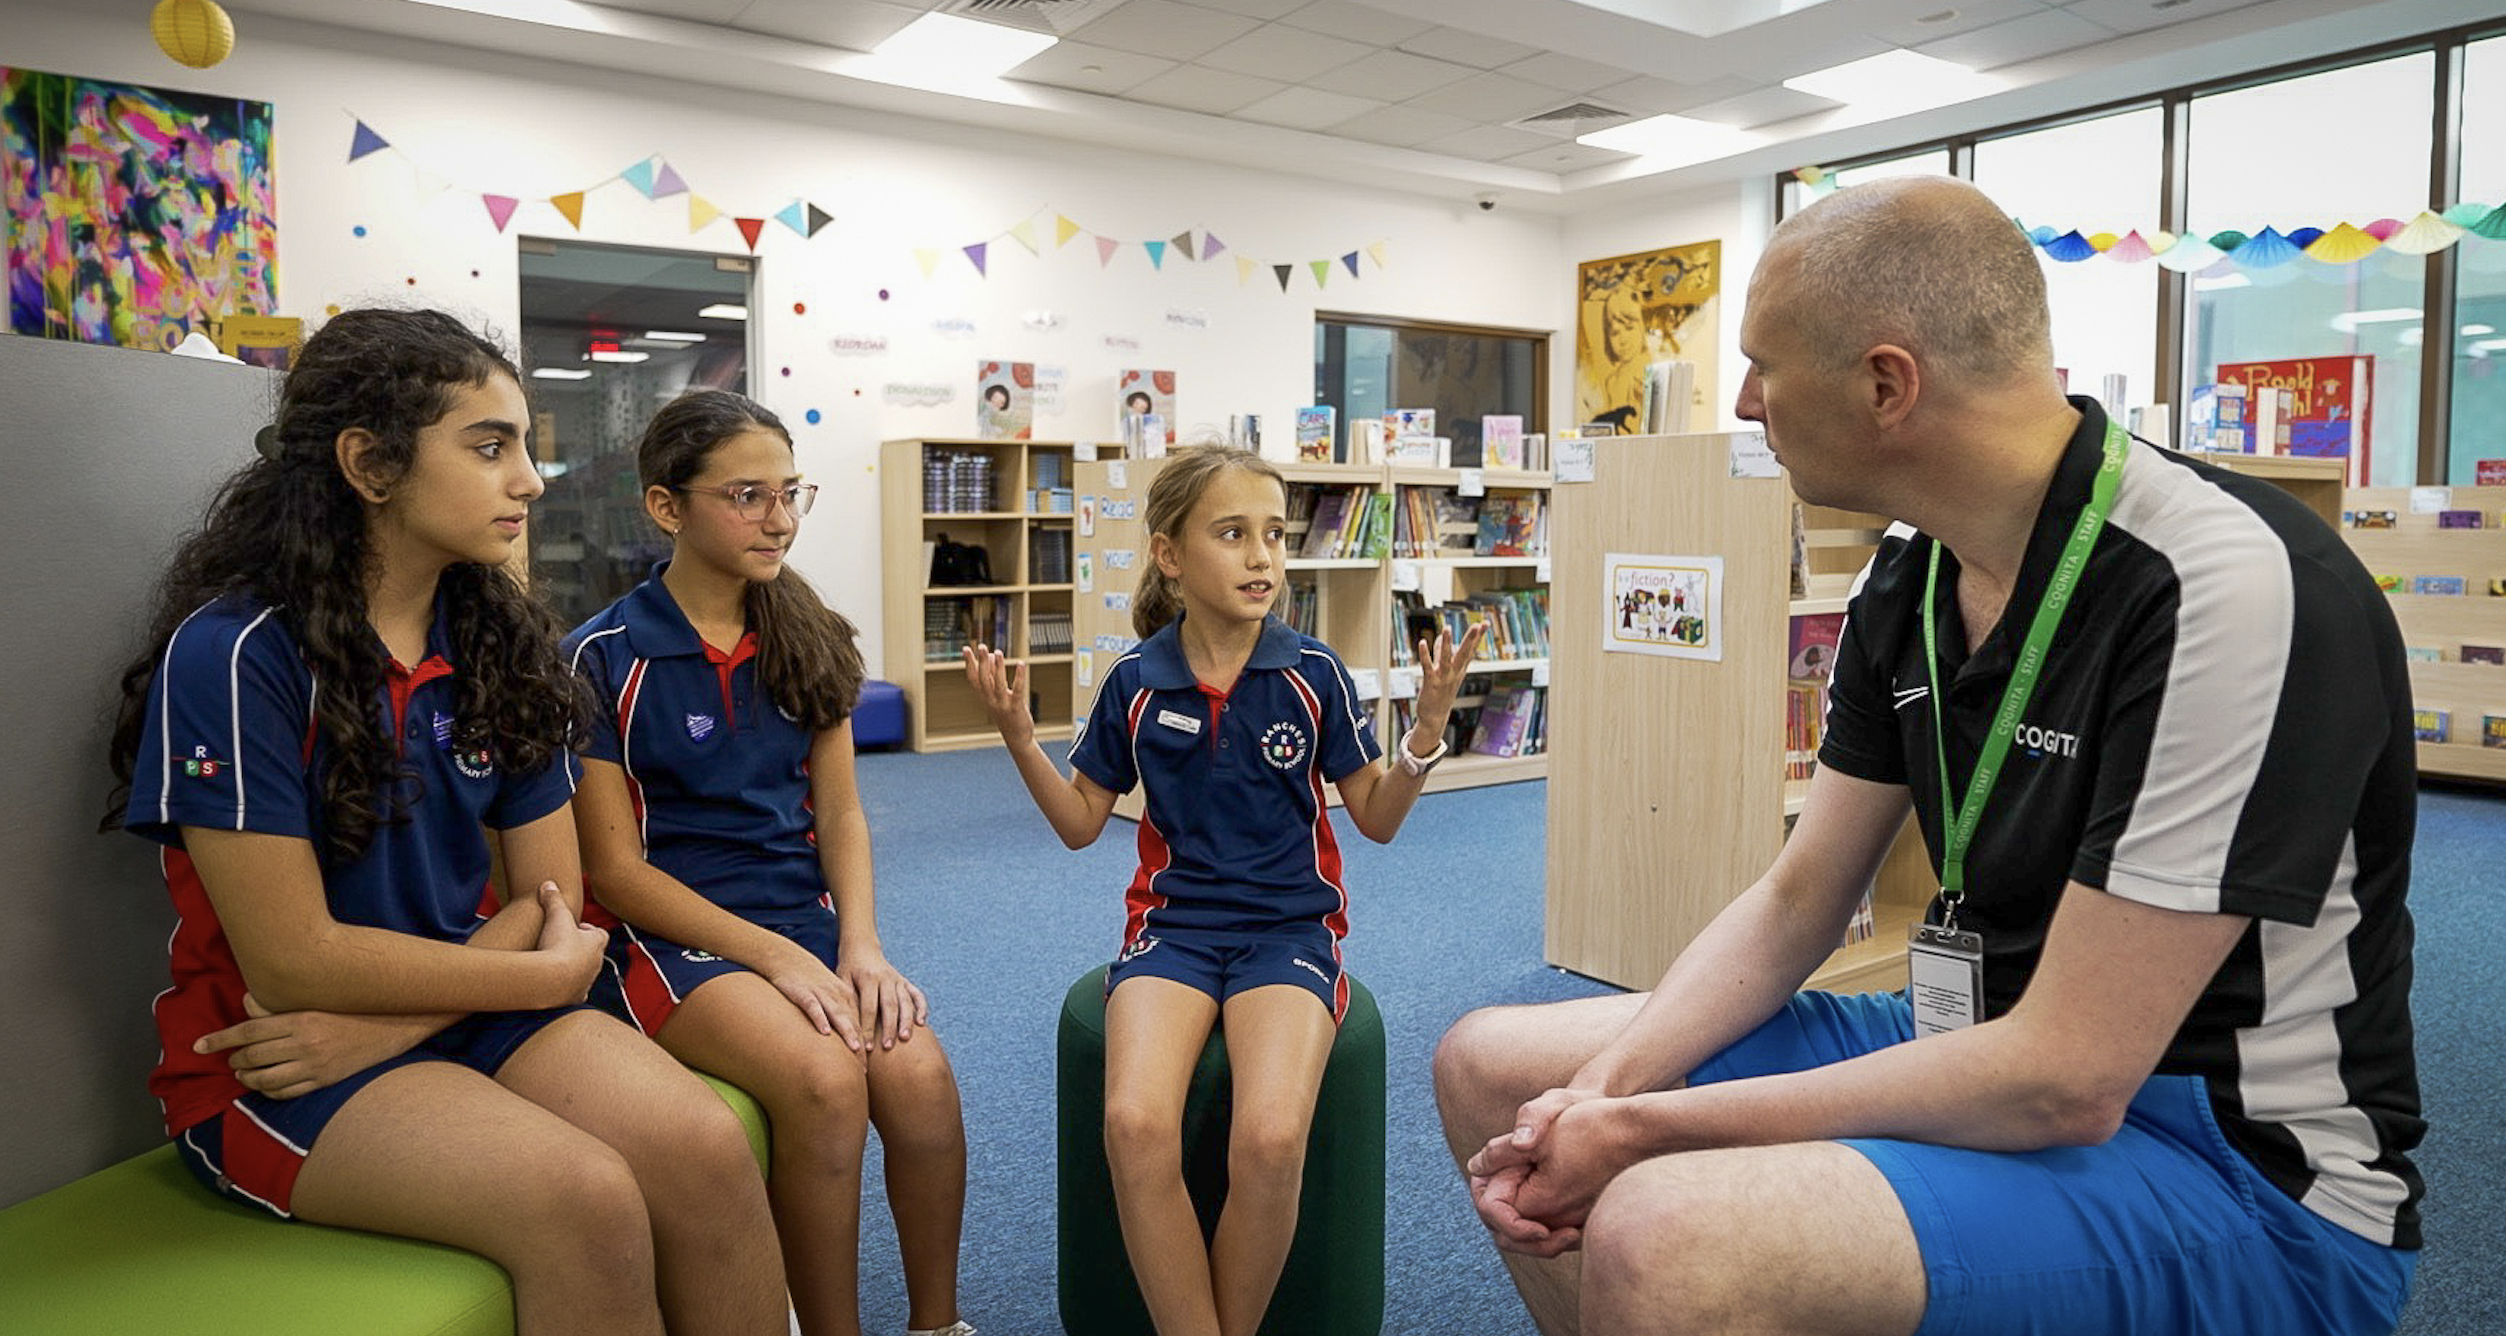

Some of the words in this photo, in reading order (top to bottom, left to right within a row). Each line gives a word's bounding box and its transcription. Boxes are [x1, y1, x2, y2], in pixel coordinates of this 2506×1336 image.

[128, 277, 257, 317] LOVE
[2242, 362, 2315, 401] Roald
[1102, 495, 1135, 517] Read
[1105, 552, 1134, 570] your
[2047, 555, 2078, 609] COGNITA
[2077, 510, 2098, 541] STAFF
[1629, 571, 1675, 590] fiction?
[1997, 687, 2025, 736] COGNITA
[2021, 645, 2039, 675] STAFF
[1261, 721, 1306, 745] RANCHES
[1281, 734, 1289, 745] R
[195, 745, 207, 758] R
[186, 761, 196, 772] P
[203, 762, 213, 774] S
